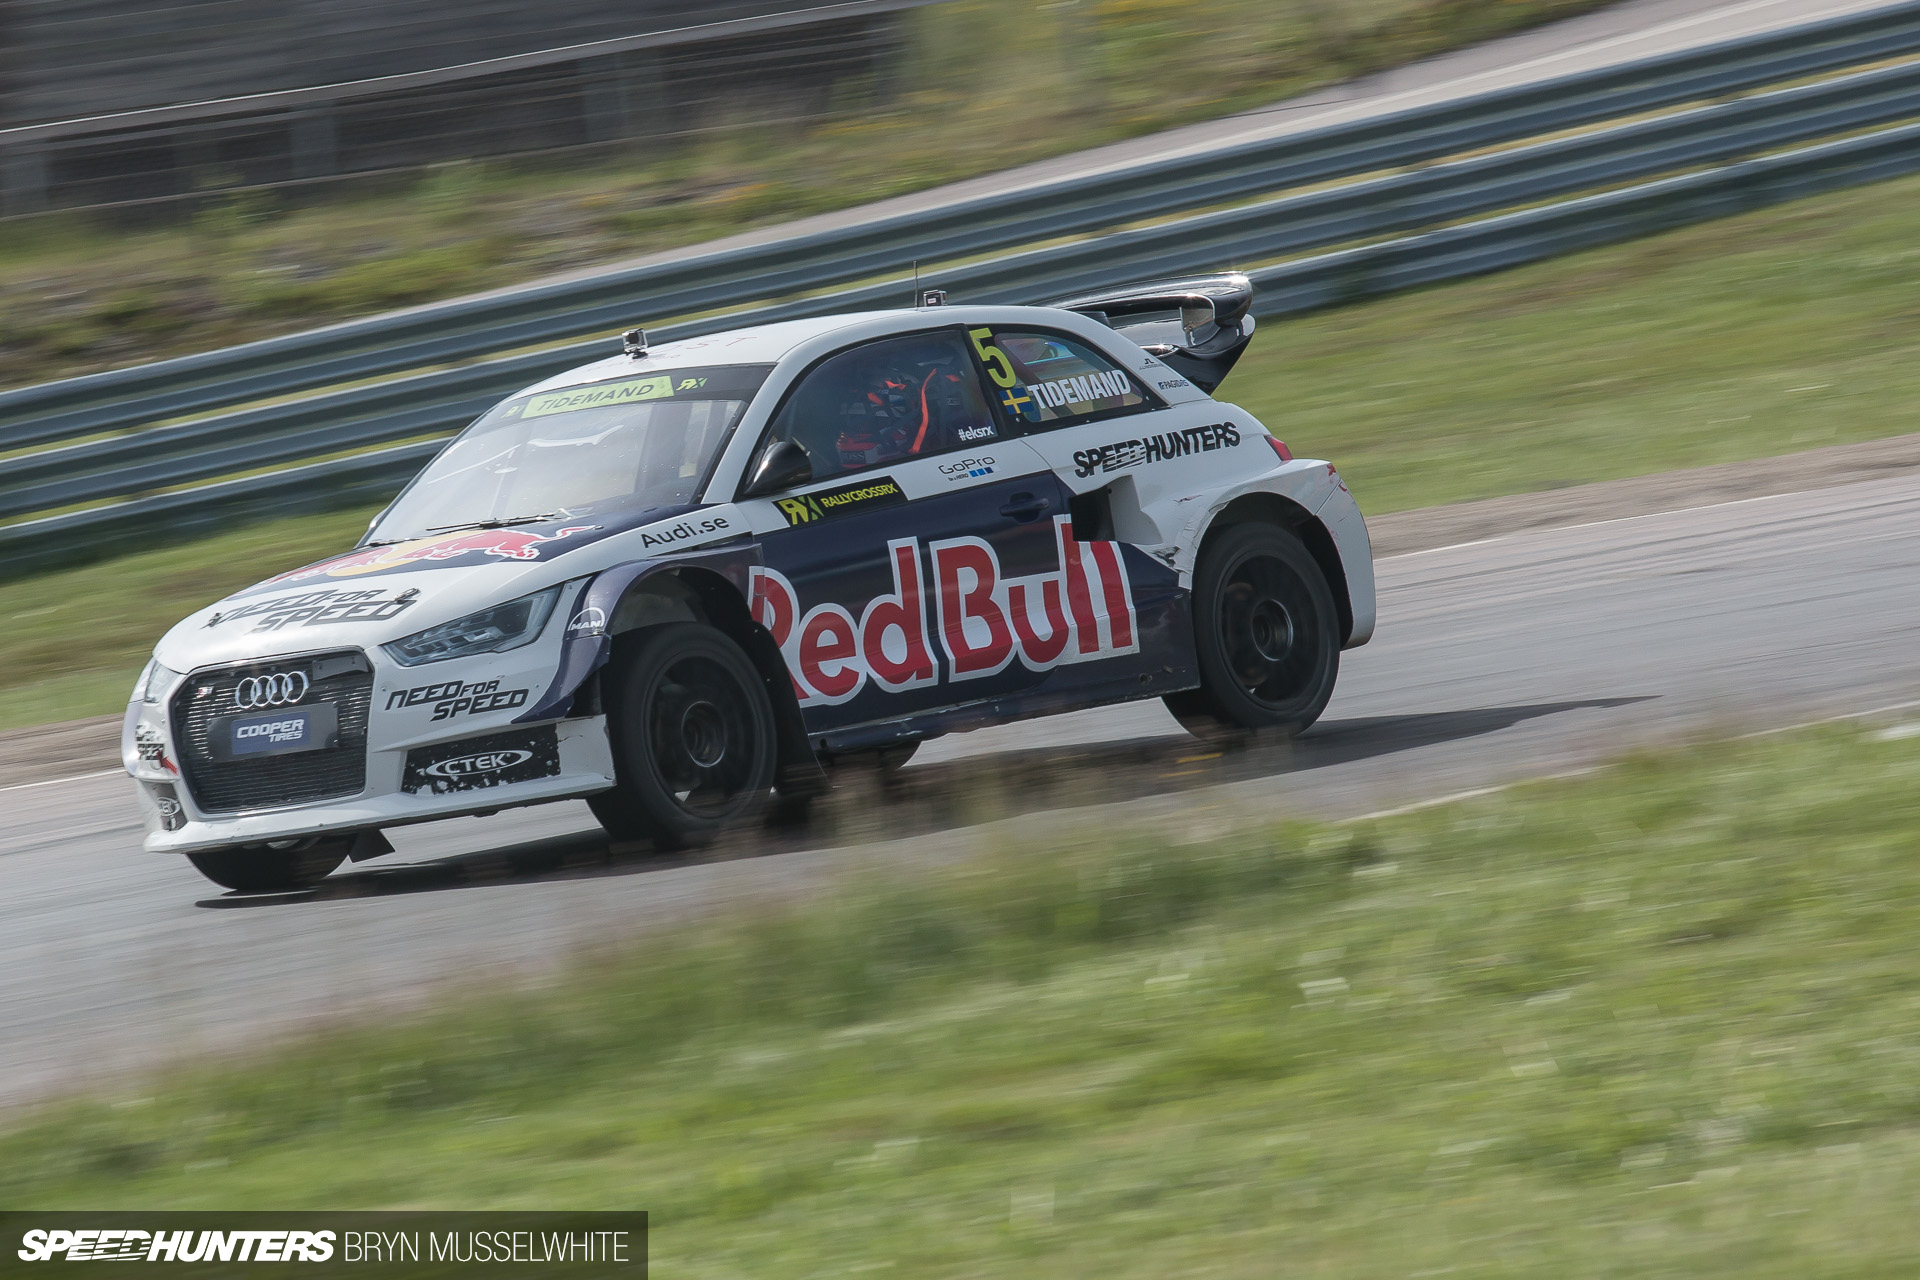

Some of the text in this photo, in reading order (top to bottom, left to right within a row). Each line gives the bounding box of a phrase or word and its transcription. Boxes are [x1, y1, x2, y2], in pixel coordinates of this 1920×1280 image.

[968, 327, 1016, 388] 5
[537, 384, 653, 412] TIDEMAND
[1027, 369, 1131, 409] TIDEMAND
[958, 426, 994, 441] #eksrx
[1072, 421, 1241, 479] SPEEDHUNTERS
[938, 456, 996, 475] GoPro
[820, 483, 899, 508] RALLYCROSSRX
[640, 516, 731, 549] Audi.se
[928, 514, 1140, 683] Bull
[243, 599, 418, 636] SPEED
[570, 620, 603, 631] MAN
[384, 679, 501, 711] NEED FOR
[429, 688, 530, 722] SPEED
[236, 718, 305, 739] COOPER
[268, 730, 303, 743] TIRES
[444, 752, 509, 774] CTEK
